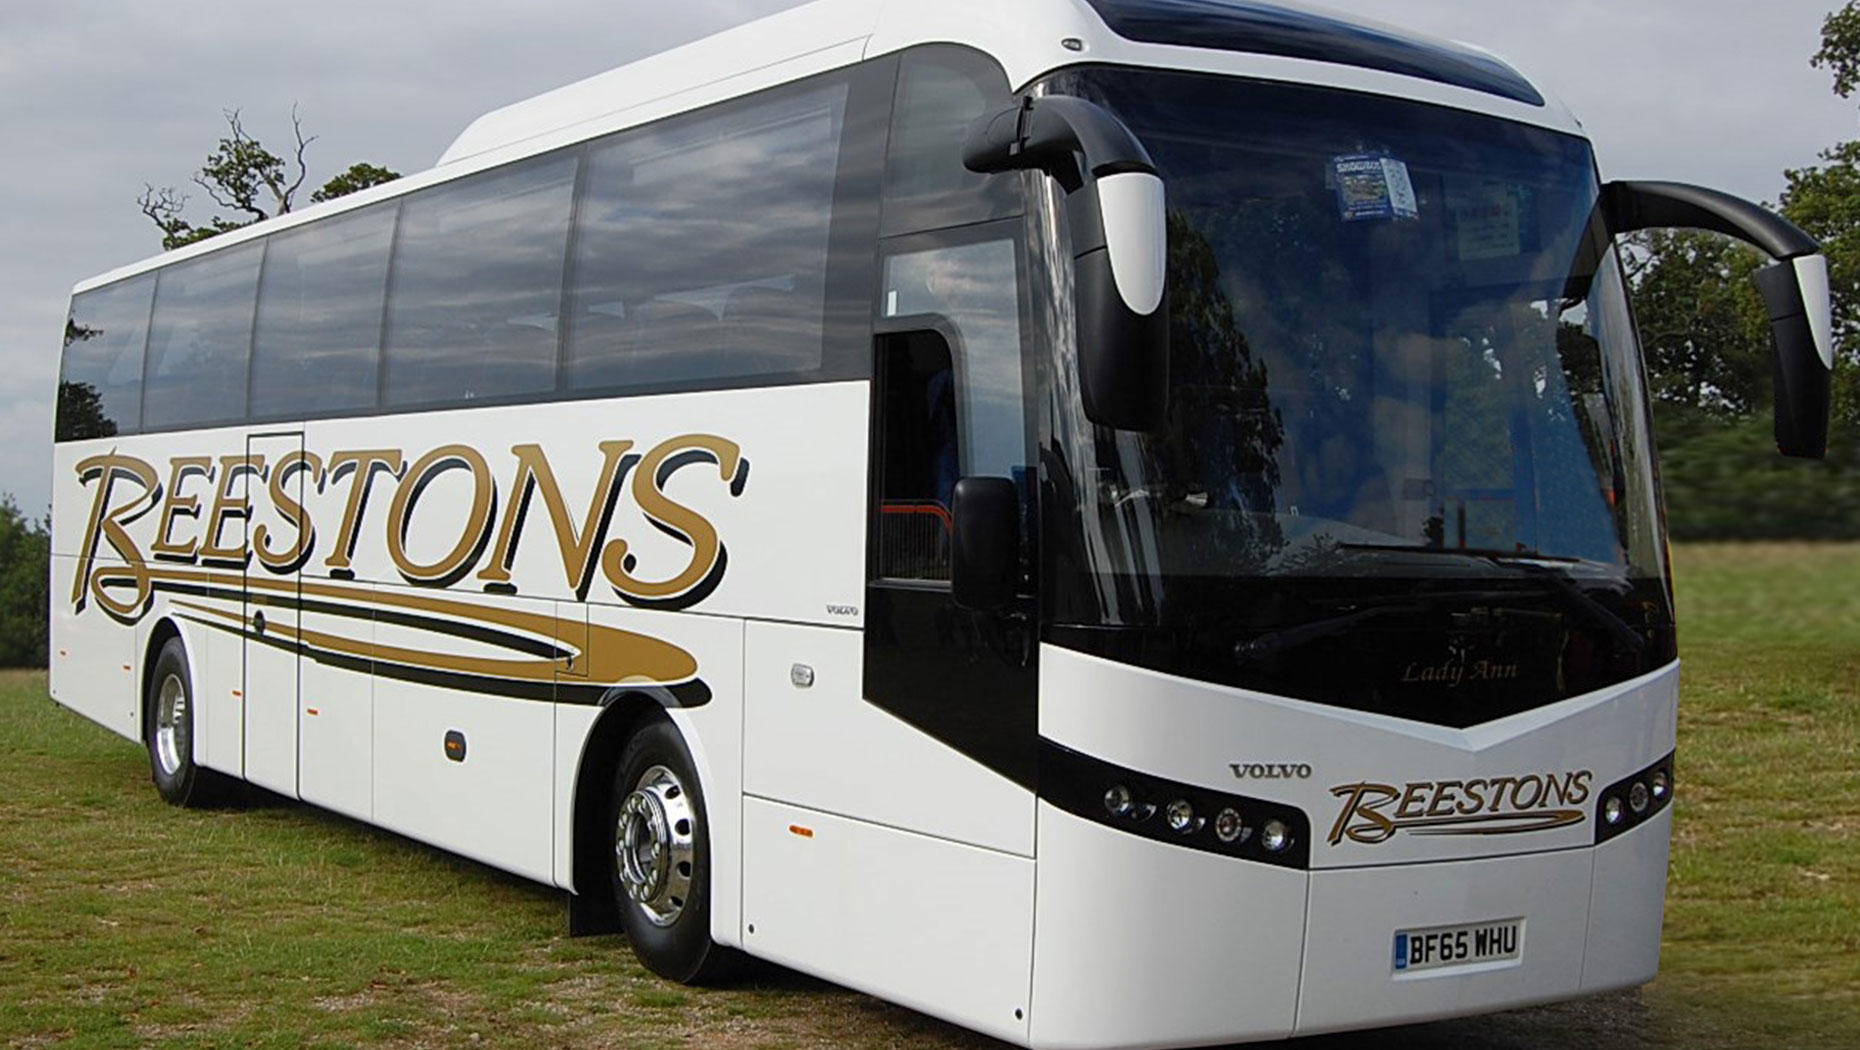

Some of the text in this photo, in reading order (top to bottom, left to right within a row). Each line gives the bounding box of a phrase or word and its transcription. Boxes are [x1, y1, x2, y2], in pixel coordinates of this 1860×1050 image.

[72, 432, 750, 626] BEESTONS
[826, 604, 859, 616] VOLVO
[1401, 658, 1519, 687] Lady Ann
[1229, 763, 1312, 779] VOLVO
[1326, 770, 1594, 847] BEESTONS
[1410, 925, 1517, 965] BF65 WHU
